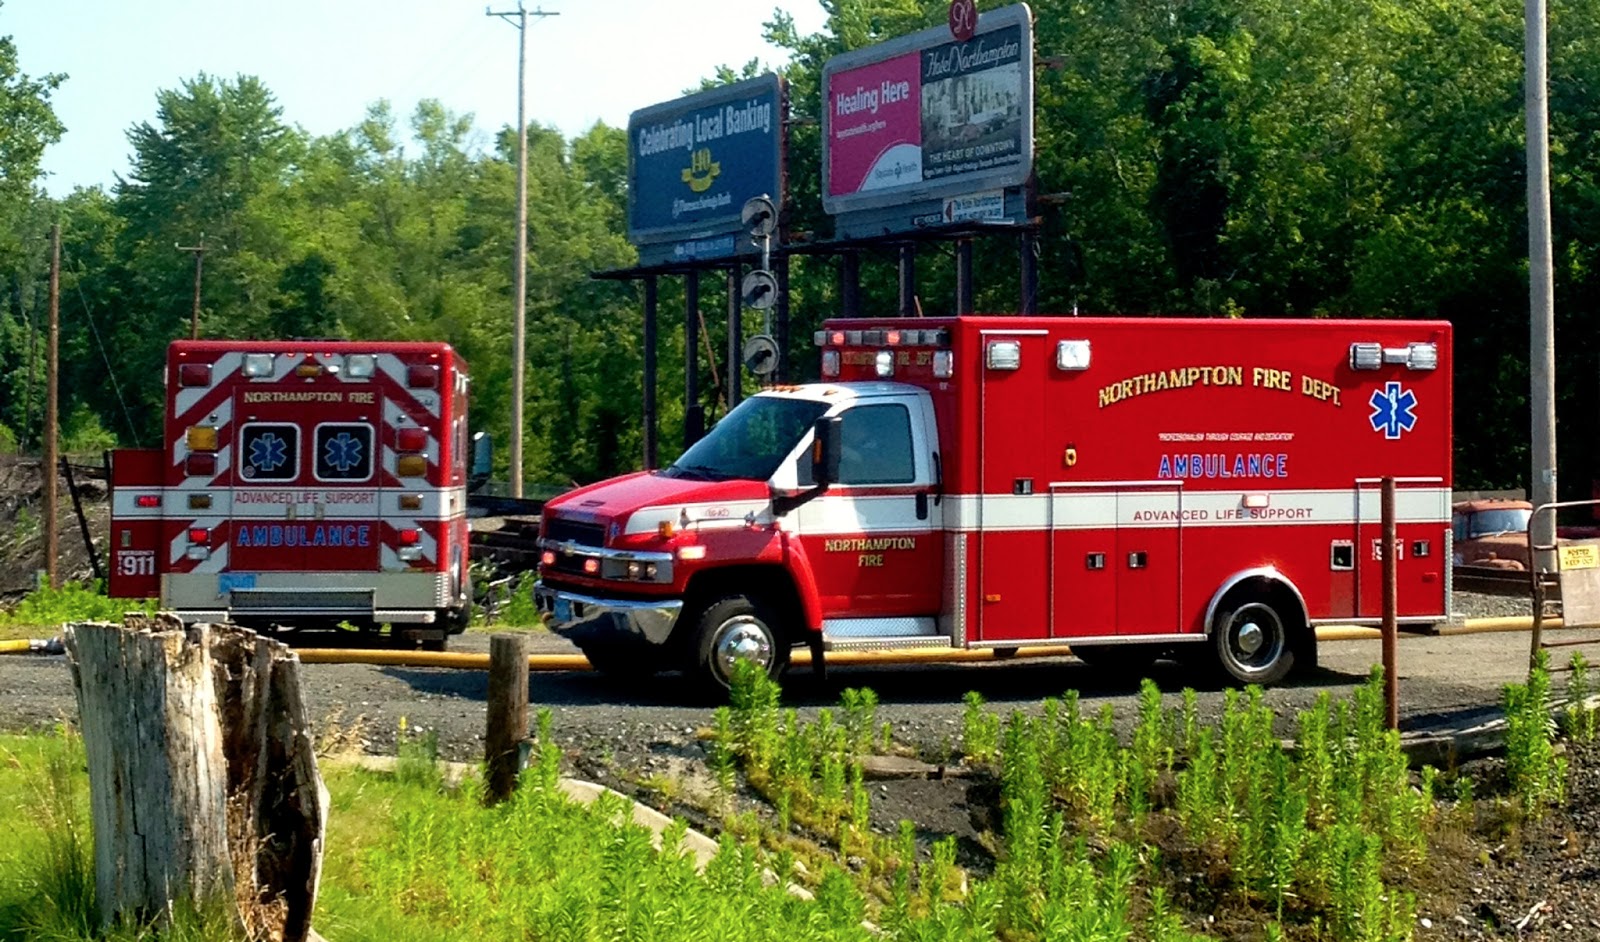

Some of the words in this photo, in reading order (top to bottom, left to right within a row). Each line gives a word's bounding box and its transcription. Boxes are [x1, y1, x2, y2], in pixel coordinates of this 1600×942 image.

[925, 52, 951, 78] Hotel
[953, 39, 1019, 74] Northampton
[836, 86, 878, 115] Healing
[881, 81, 909, 104] Here
[639, 119, 693, 156] Celebrating
[696, 108, 723, 143] Local
[726, 99, 771, 136] Banking
[929, 153, 942, 163] THE
[943, 149, 964, 161] HEART
[965, 147, 975, 158] OF
[975, 139, 1015, 156] DOWNTOWN
[244, 391, 342, 403] NORTHAMPTON
[349, 392, 375, 404] FIRE
[1098, 366, 1243, 408] NORTHAMPTON
[1252, 367, 1292, 391] FIRE
[1302, 375, 1341, 406] DEPT.
[1158, 453, 1288, 479] AMBULANCE
[235, 492, 293, 505] ADVANCED
[297, 492, 319, 504] LIFE
[325, 492, 375, 505] SUPPORT
[1133, 509, 1208, 522] ADVANCED
[1216, 509, 1243, 520] LIFE
[1250, 508, 1313, 520] SUPPORT
[237, 525, 370, 548] AMBULANCE
[825, 537, 916, 551] NORTHAMPTON
[124, 556, 155, 575] 911
[858, 553, 884, 567] FIRE
